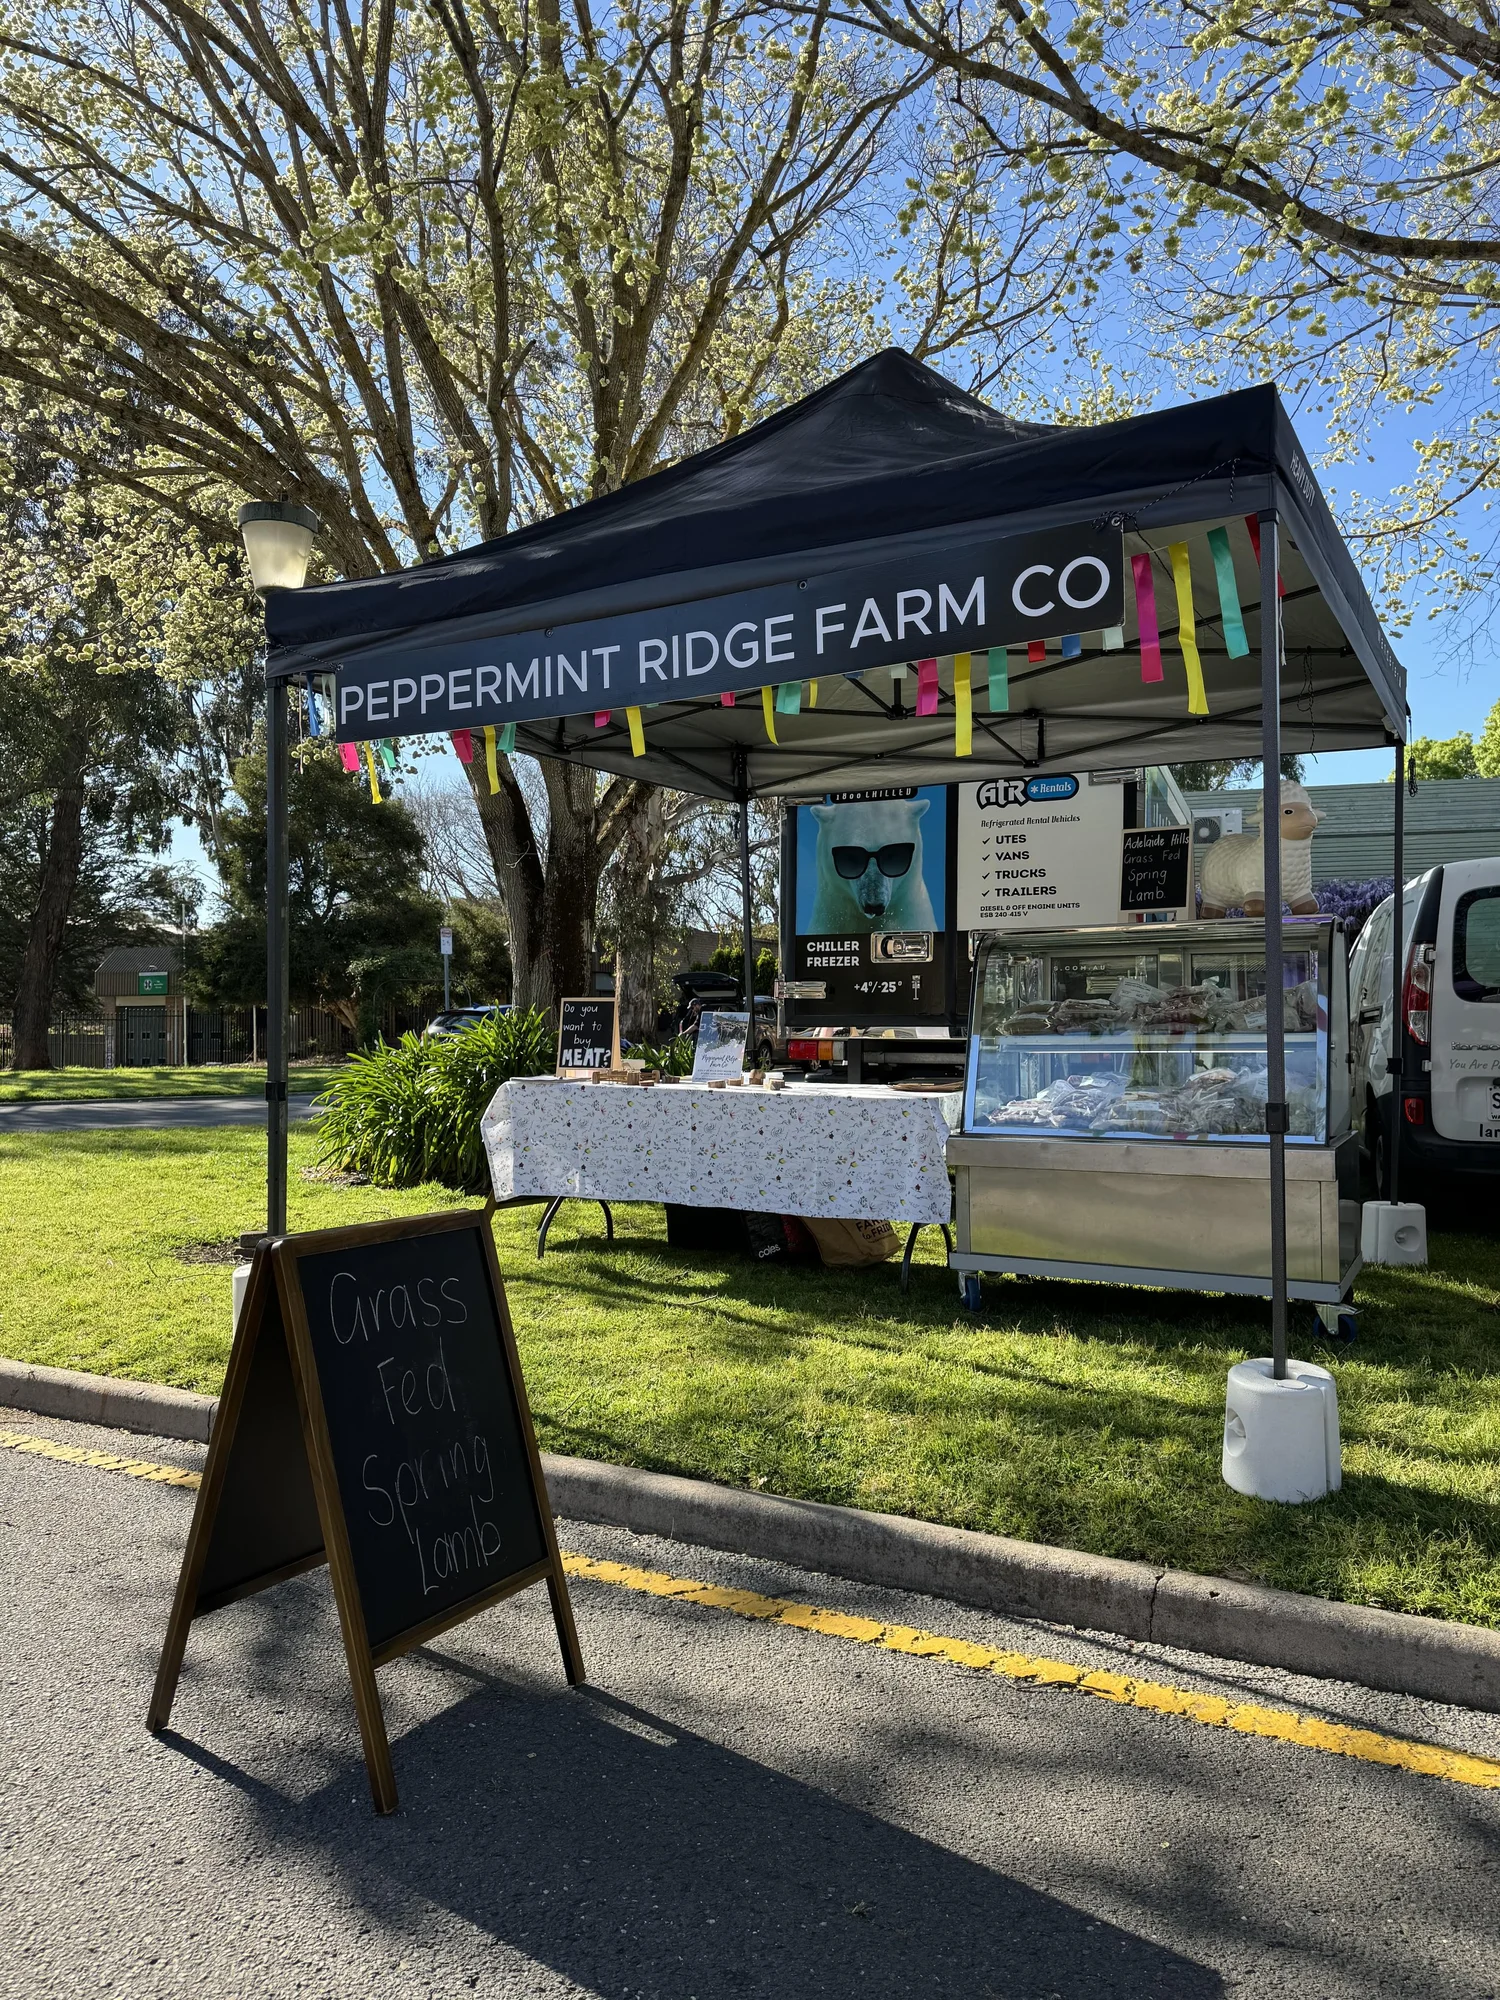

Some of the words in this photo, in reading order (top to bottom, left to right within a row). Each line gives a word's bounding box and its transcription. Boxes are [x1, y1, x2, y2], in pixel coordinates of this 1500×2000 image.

[340, 645, 620, 725] PEPPERMINT
[639, 613, 795, 684] RIDGE
[816, 576, 985, 654] FARM
[1011, 556, 1110, 617] CO
[1040, 782, 1072, 793] Rentals
[981, 818, 1025, 828] Refrigerated
[1027, 816, 1050, 825] Rental
[1051, 814, 1080, 823] Vehicles
[996, 834, 1026, 844] UTES
[1124, 834, 1164, 849] Adelaide
[1171, 832, 1190, 846] Hills
[995, 851, 1030, 861] VANS
[1124, 854, 1153, 864] Grass
[1163, 848, 1180, 861] Fed
[995, 868, 1046, 880] TRUCKS
[1128, 869, 1167, 887] Spring
[995, 886, 1057, 897] TRAILERS
[807, 941, 860, 952] CHILLER
[807, 956, 860, 967] FREEZER
[564, 1003, 575, 1013] Do
[580, 1006, 598, 1017] you
[563, 1021, 585, 1031] want
[592, 1020, 602, 1031] to
[574, 1033, 592, 1050] buy
[561, 1047, 611, 1068] MEAT?
[1450, 1059, 1466, 1069] You
[1468, 1059, 1488, 1070] Are
[856, 1219, 883, 1232] FAR
[758, 1244, 781, 1258] coles
[330, 1272, 468, 1345] Grass
[377, 1336, 456, 1425] Fed
[362, 1435, 494, 1545] Spring
[416, 1495, 501, 1596] Lamb
